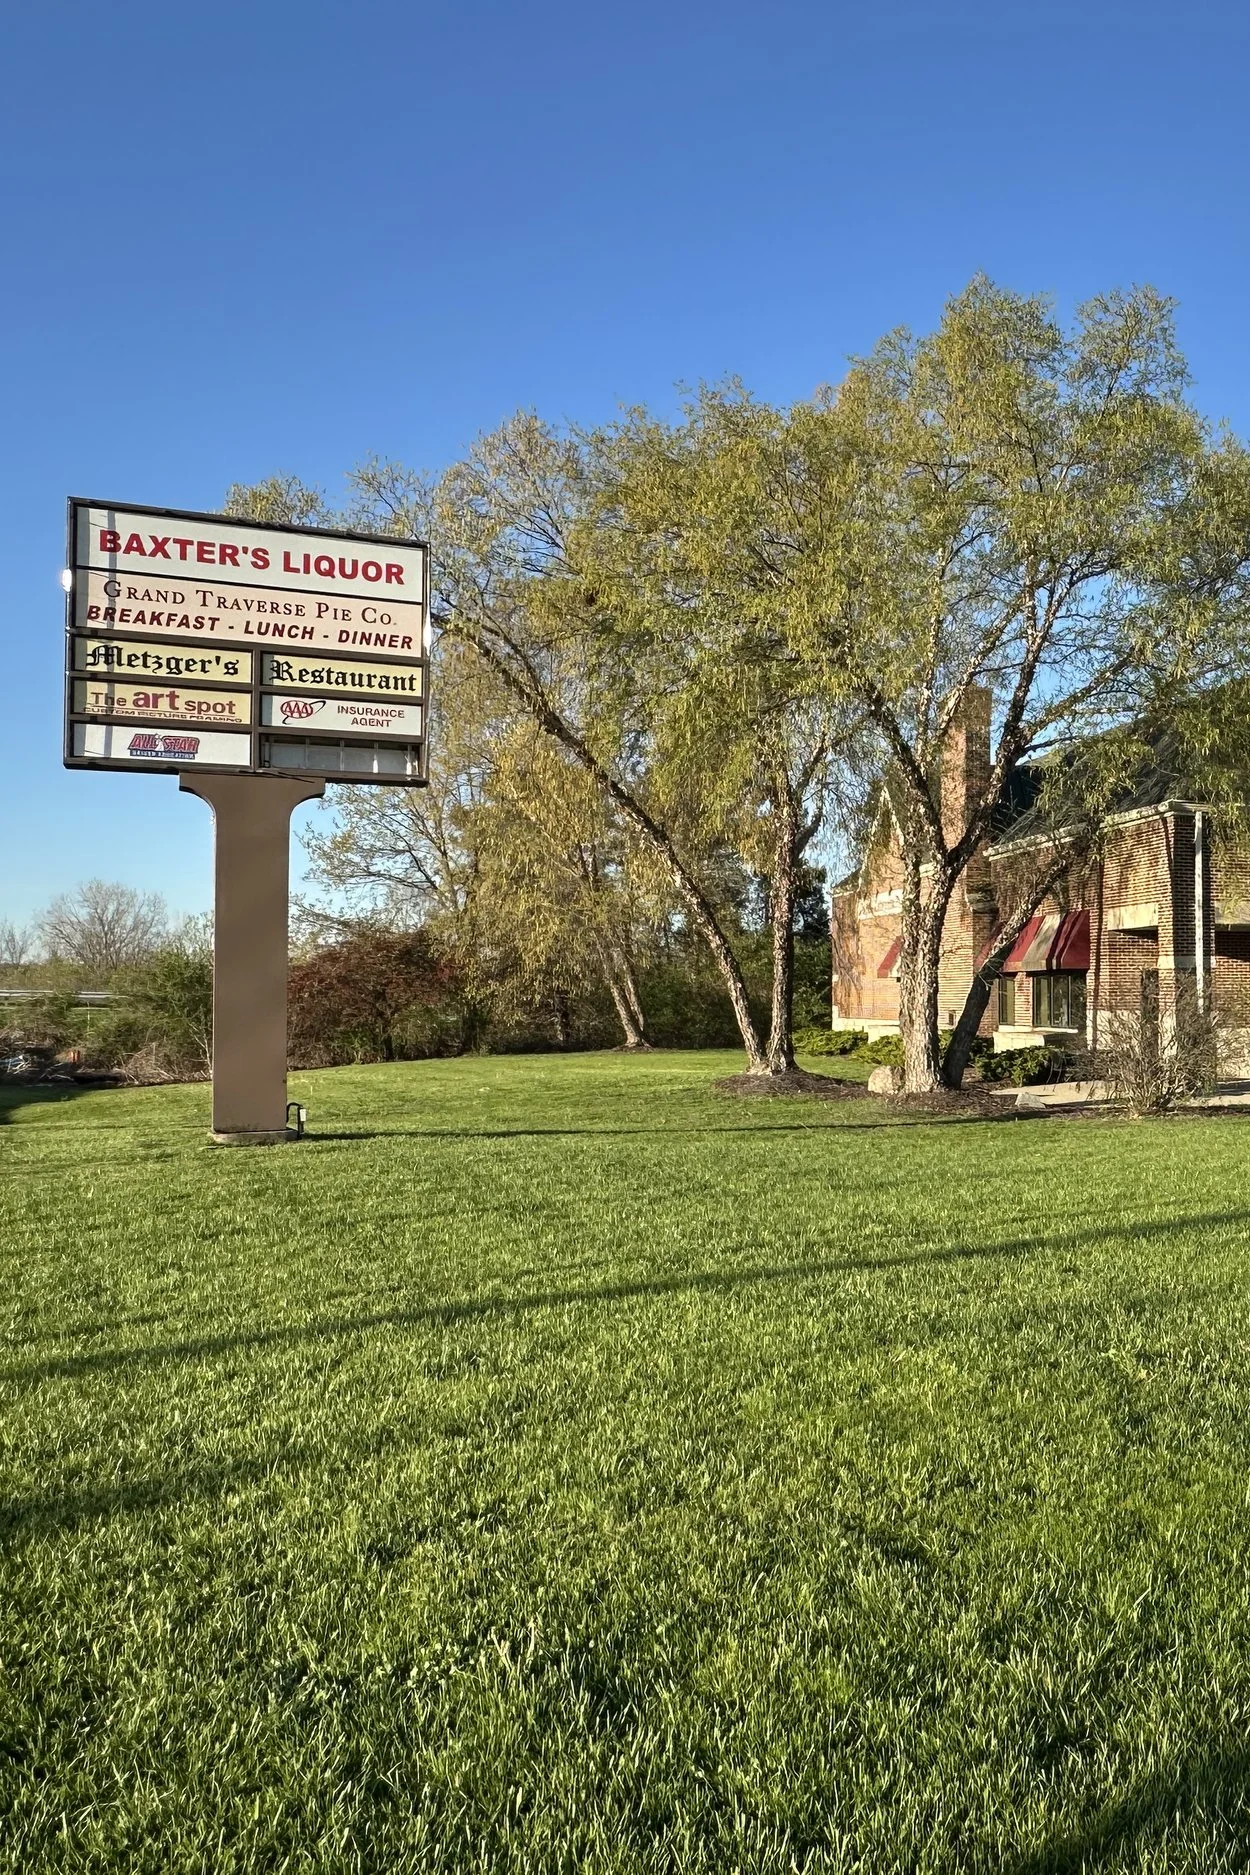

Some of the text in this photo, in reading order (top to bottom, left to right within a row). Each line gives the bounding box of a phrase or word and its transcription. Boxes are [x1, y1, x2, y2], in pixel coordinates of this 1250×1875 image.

[99, 529, 405, 585] BAXTER'S LIQUOR
[86, 605, 220, 631] BREAKFAST
[243, 620, 315, 641] LUNCH
[337, 629, 413, 650] DINNER
[86, 644, 417, 692] Metzger's Restaurant
[90, 690, 236, 716] The art spot
[337, 705, 405, 719] INSURANCE
[351, 717, 392, 728] AGENT
